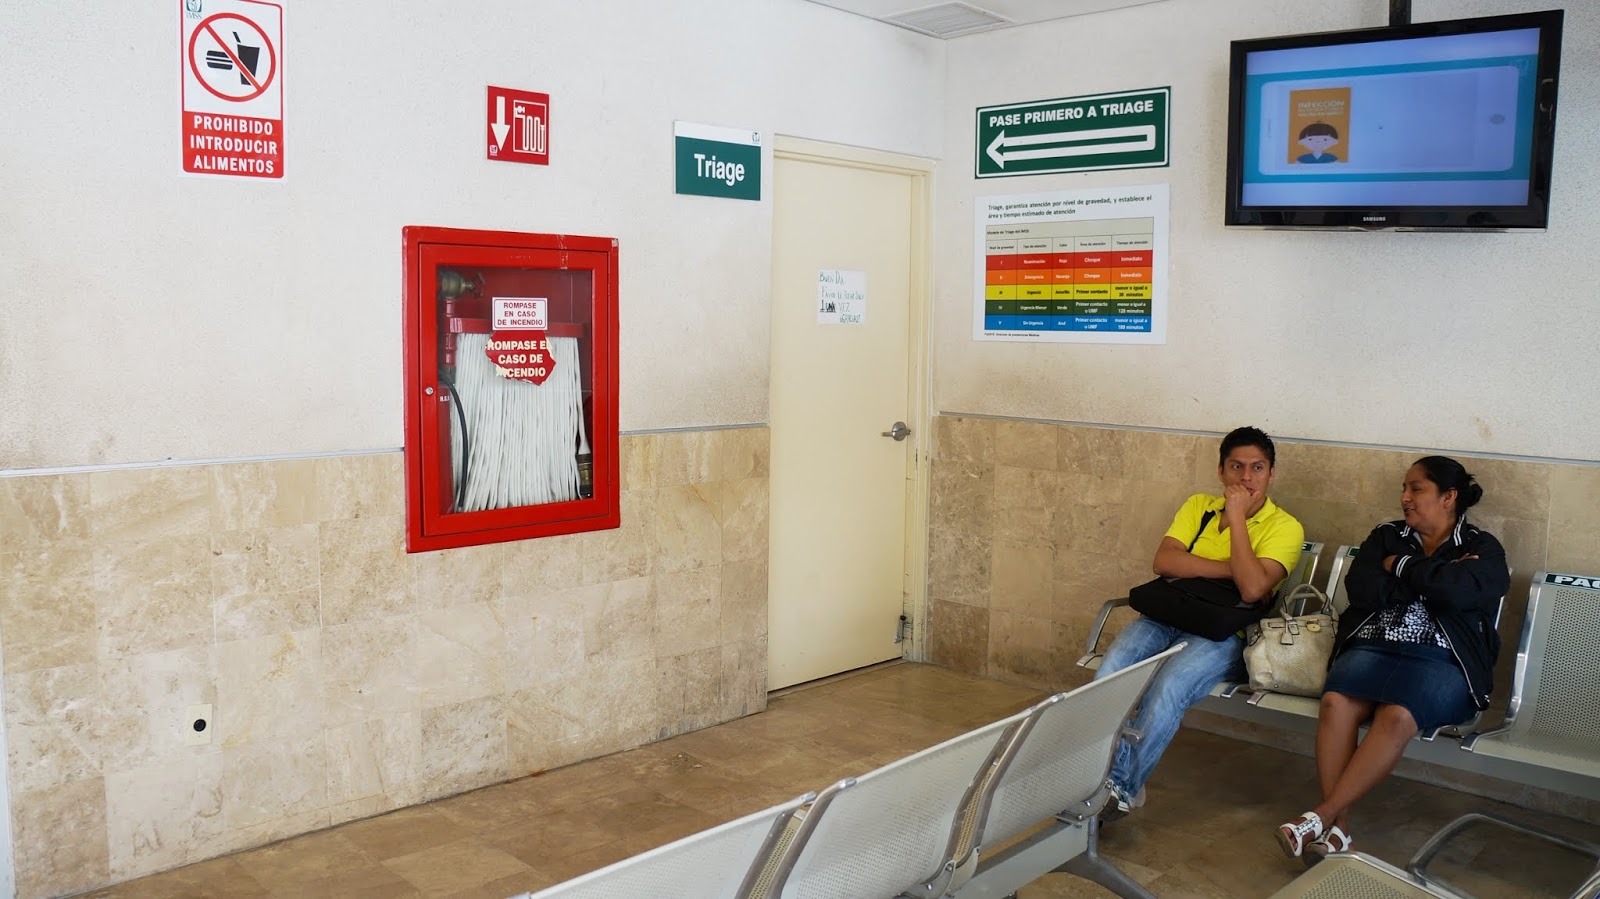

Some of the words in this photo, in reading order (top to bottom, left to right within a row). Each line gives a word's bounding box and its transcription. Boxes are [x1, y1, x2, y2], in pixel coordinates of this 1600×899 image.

[990, 114, 1021, 127] PASE
[1024, 107, 1083, 124] PRIMERO
[1087, 106, 1097, 118] A
[1100, 100, 1154, 116] TRIAGE
[194, 115, 273, 136] PROHIBIDO
[190, 135, 277, 155] INTRODUCIR
[194, 155, 274, 174] ALIMENTOS
[694, 153, 744, 186] Triage
[487, 340, 537, 350] ROMPASE
[498, 354, 527, 364] CASO
[530, 354, 543, 364] DE
[499, 368, 546, 377] CENDIO
